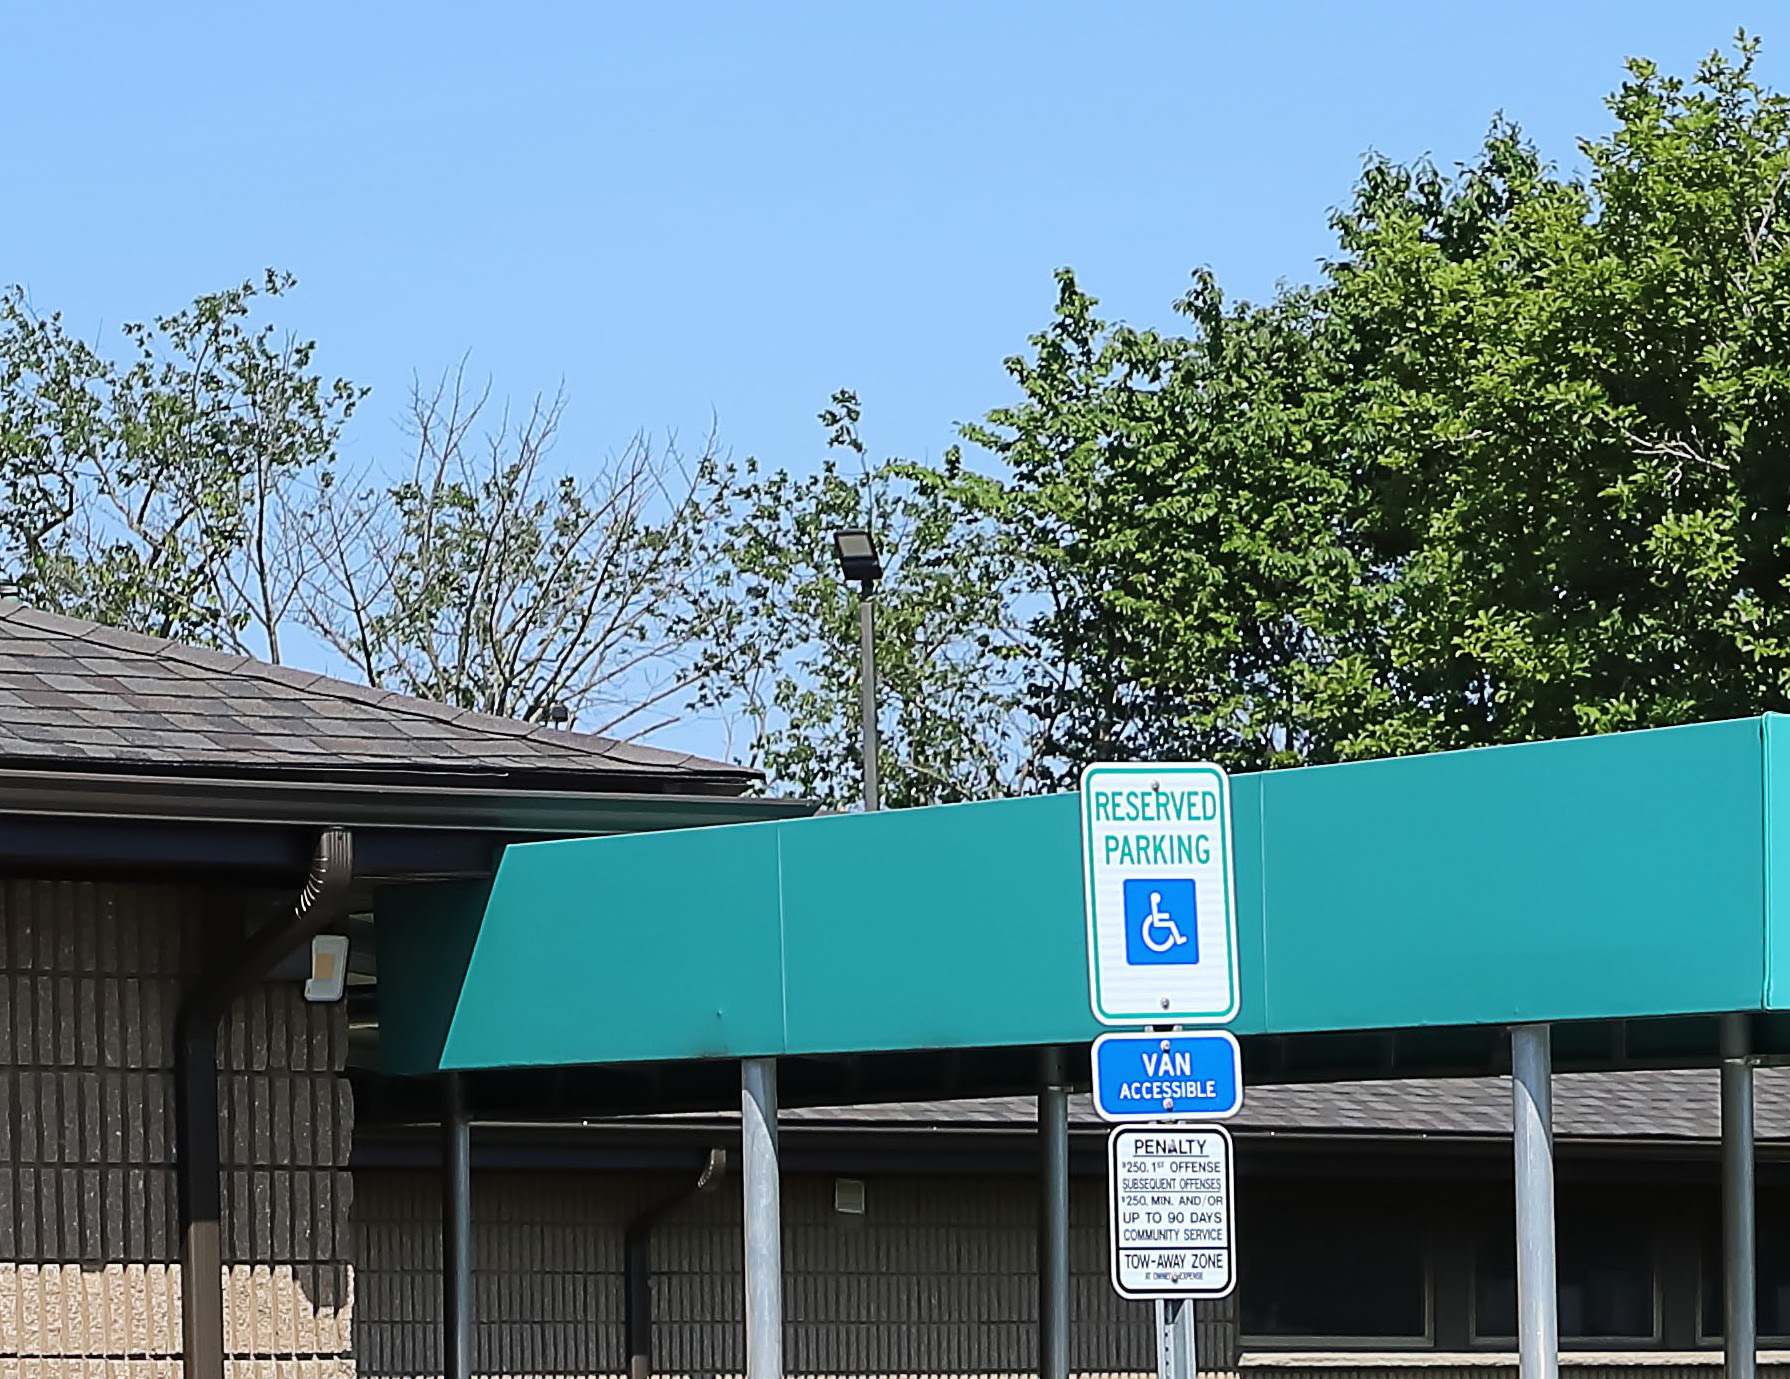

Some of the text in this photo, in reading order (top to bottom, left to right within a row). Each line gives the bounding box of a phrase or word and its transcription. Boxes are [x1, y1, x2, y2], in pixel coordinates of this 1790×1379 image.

[1095, 791, 1217, 821] RESERVED
[1105, 835, 1210, 865] PARKING
[1142, 1052, 1192, 1077] VAN
[1119, 1080, 1216, 1100] ACCESSIBLE
[1134, 1138, 1207, 1155] PENALTY
[1170, 1161, 1221, 1173] OFFENSE
[1122, 1178, 1222, 1190] SUBSEQUENT OFFENSES
[1179, 1195, 1223, 1207] AND/OR
[1123, 1211, 1222, 1224] UP TO 90 DAYS
[1123, 1228, 1223, 1241] COMMUNITY SERVICE
[1124, 1253, 1224, 1270] TOW-AWAY ZONE
